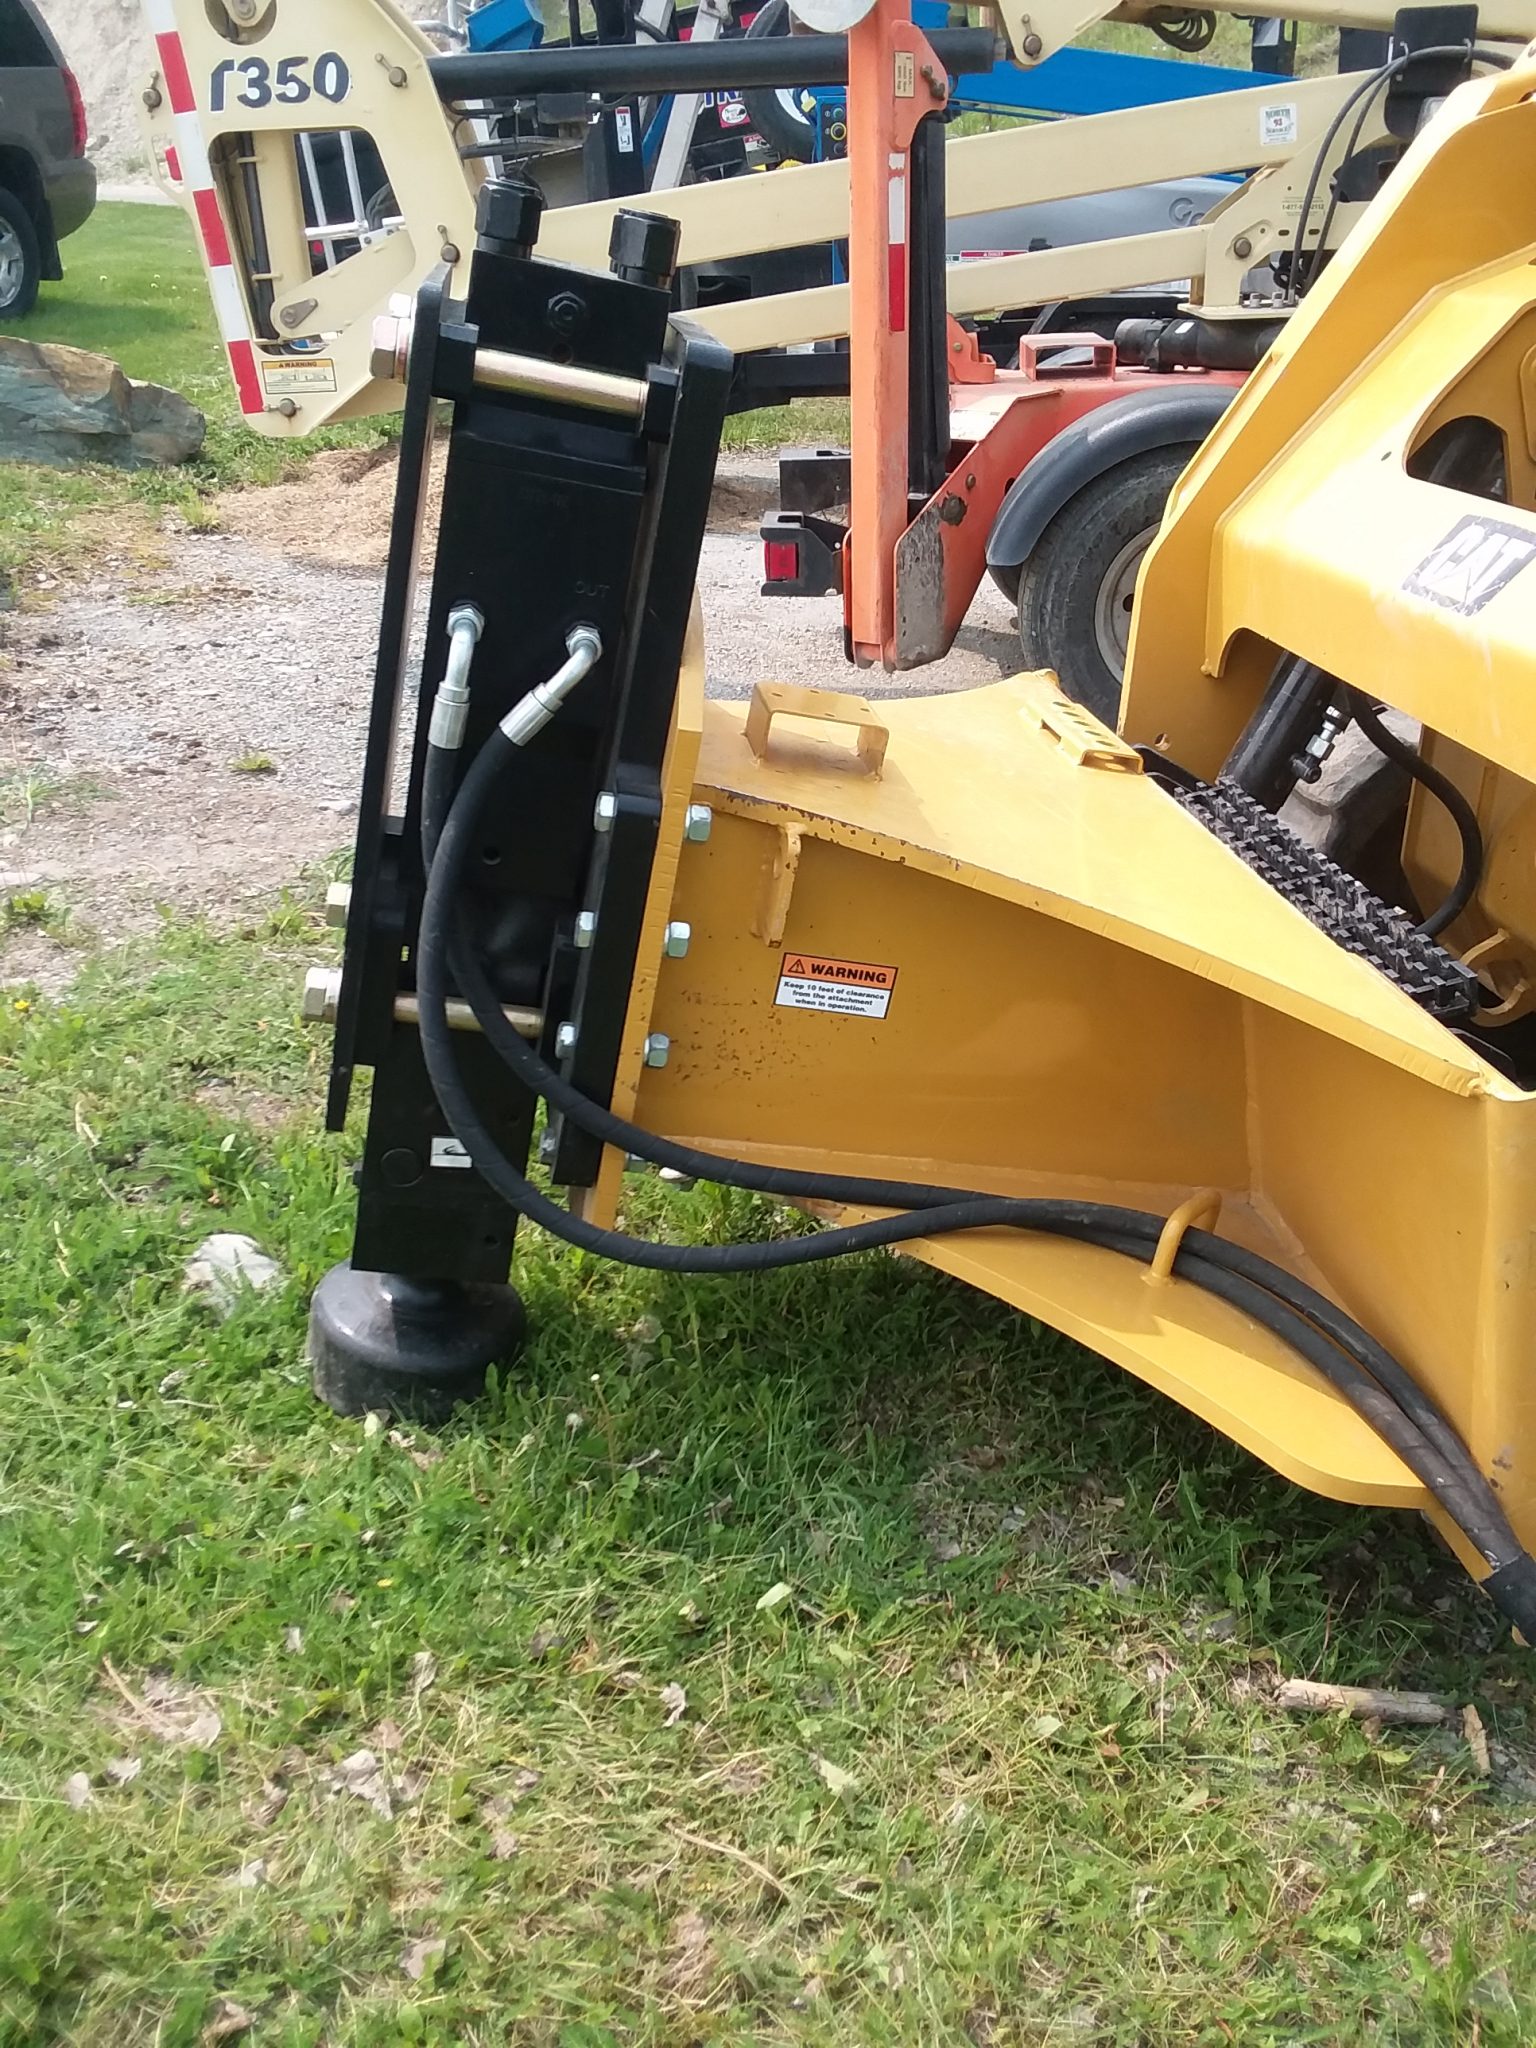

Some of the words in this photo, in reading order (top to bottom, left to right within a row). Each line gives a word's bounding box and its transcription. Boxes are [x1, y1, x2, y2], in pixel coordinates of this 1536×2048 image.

[1412, 522, 1536, 608] CAT
[811, 963, 887, 984] WARNING
[784, 981, 805, 990] Keep
[819, 985, 834, 993] feet
[836, 987, 845, 995] of
[846, 989, 885, 1000] clearance
[792, 990, 811, 998] from
[812, 992, 826, 1000] the
[827, 994, 873, 1006] attachment
[795, 998, 816, 1006] when
[827, 1002, 867, 1013] operation.
